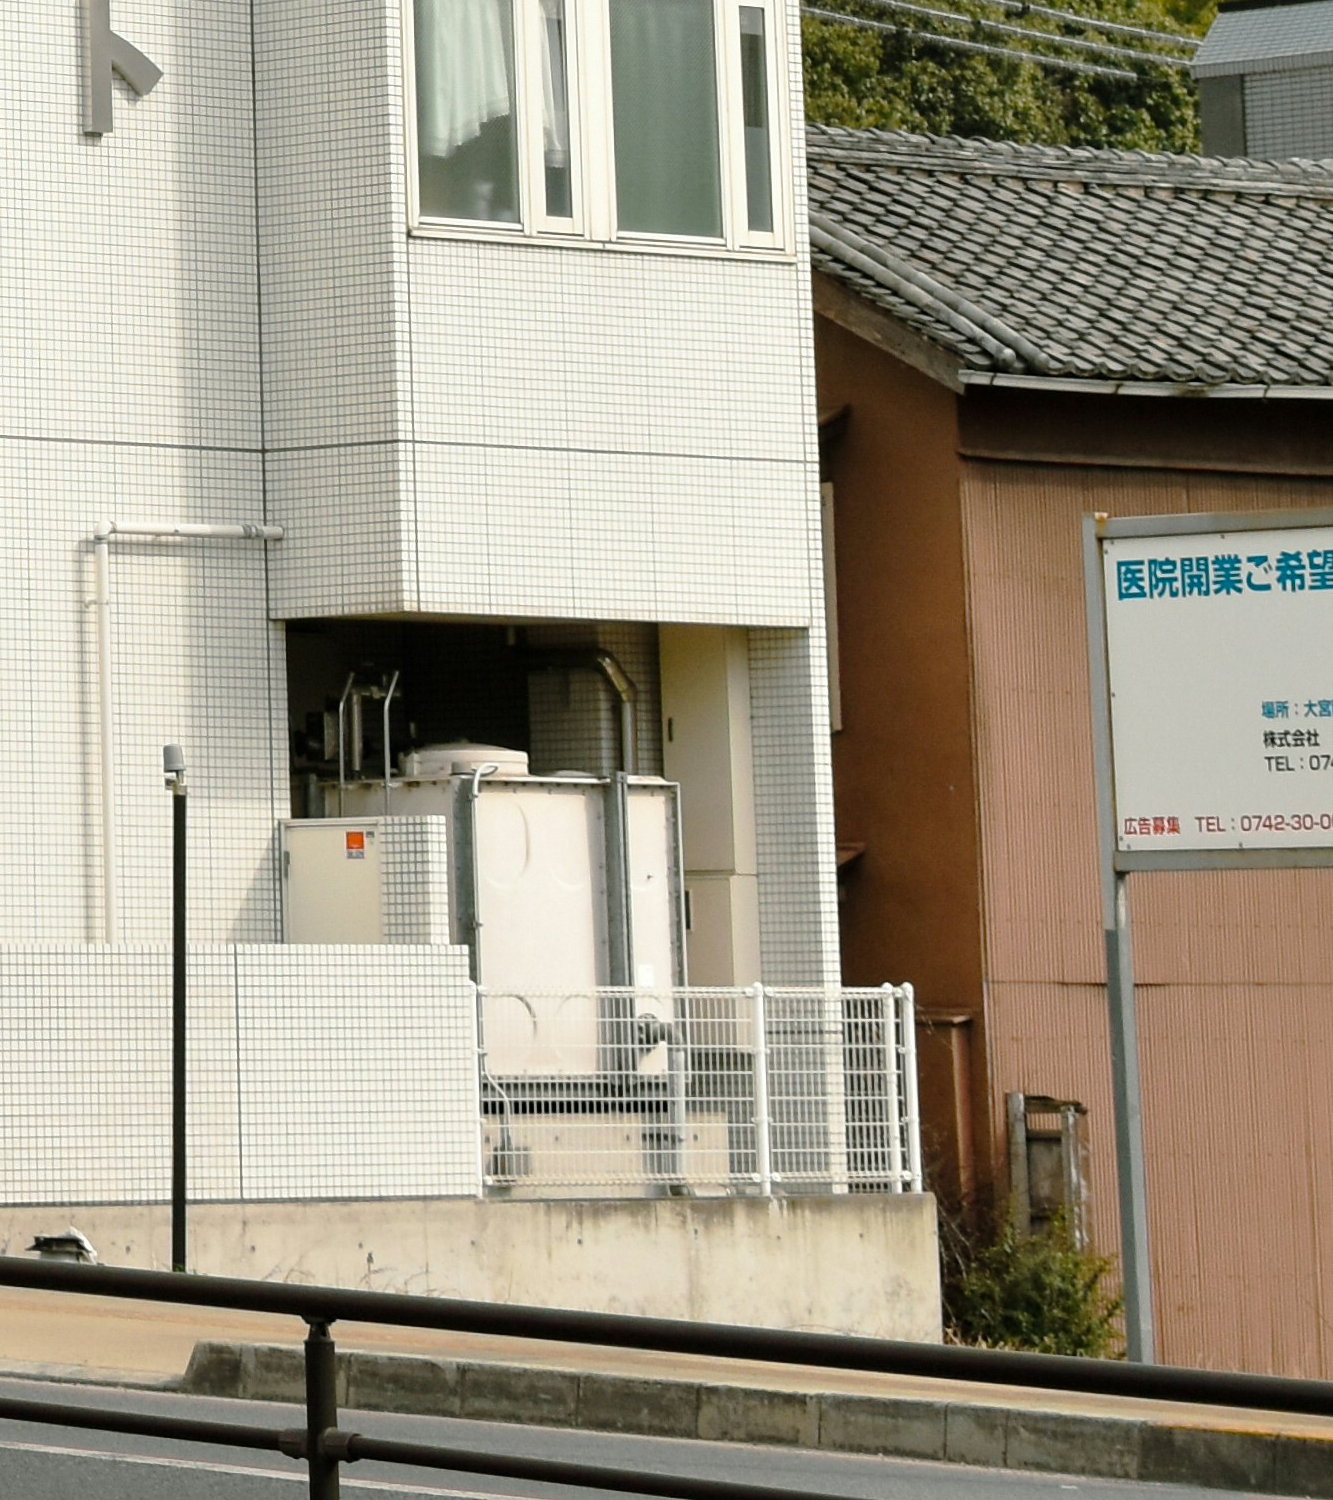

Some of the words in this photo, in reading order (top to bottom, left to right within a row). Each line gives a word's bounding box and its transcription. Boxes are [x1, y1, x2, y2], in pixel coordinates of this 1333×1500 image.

[1117, 550, 1333, 601] 医院開業ご希望
[1263, 729, 1320, 748] 株式会社
[1264, 755, 1333, 772] TEL：07
[1124, 816, 1181, 835] 広告募集
[1195, 813, 1333, 833] TEL：0742-30-0
